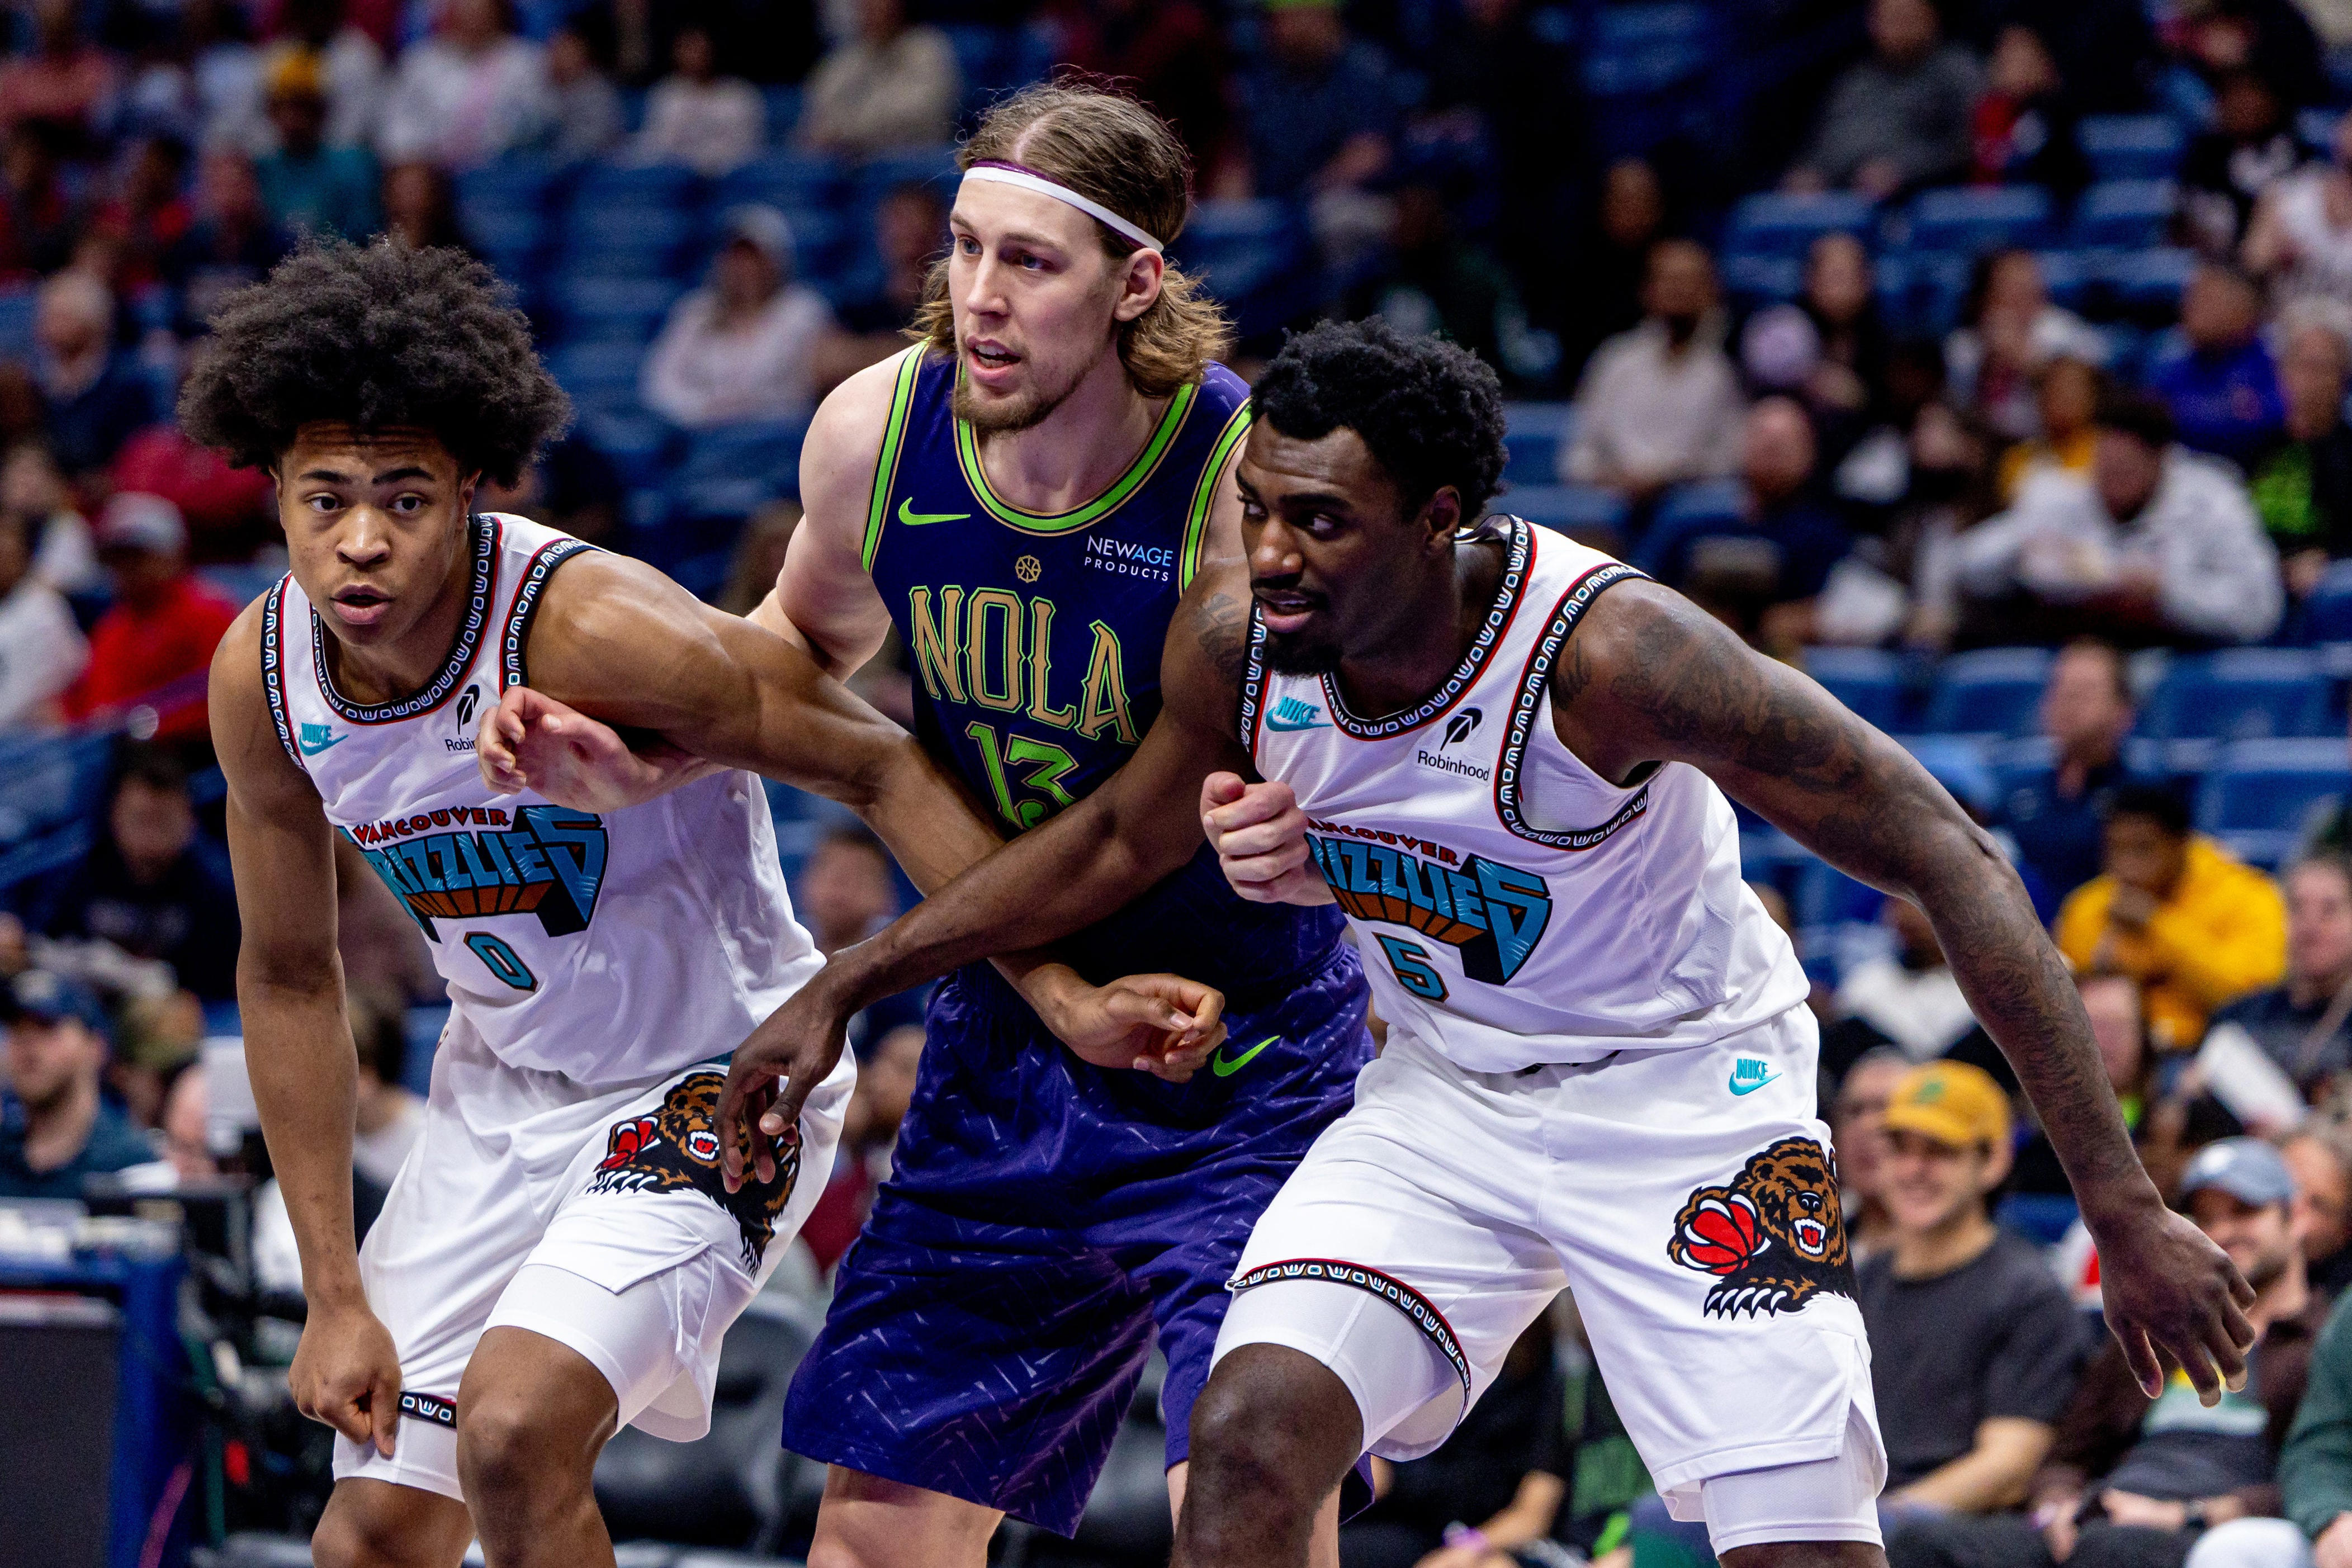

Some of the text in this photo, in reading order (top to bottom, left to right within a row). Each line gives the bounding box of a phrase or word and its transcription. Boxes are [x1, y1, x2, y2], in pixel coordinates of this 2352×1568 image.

[1085, 557, 1168, 581] PRODUCTS
[1087, 534, 1173, 567] NEWAGE
[909, 585, 1141, 745] NOLA
[1275, 696, 1321, 726] NIKE
[301, 722, 332, 745] NIKE
[965, 721, 1079, 830] 13
[1418, 750, 1490, 781] Robinhood
[352, 806, 511, 846] VANCOUVER
[1307, 816, 1460, 865] ANCOUVER
[337, 804, 609, 943] RIZZLIES
[463, 931, 538, 992] 0
[1371, 932, 1450, 1003] 5
[1736, 1059, 1768, 1080] NIKE
